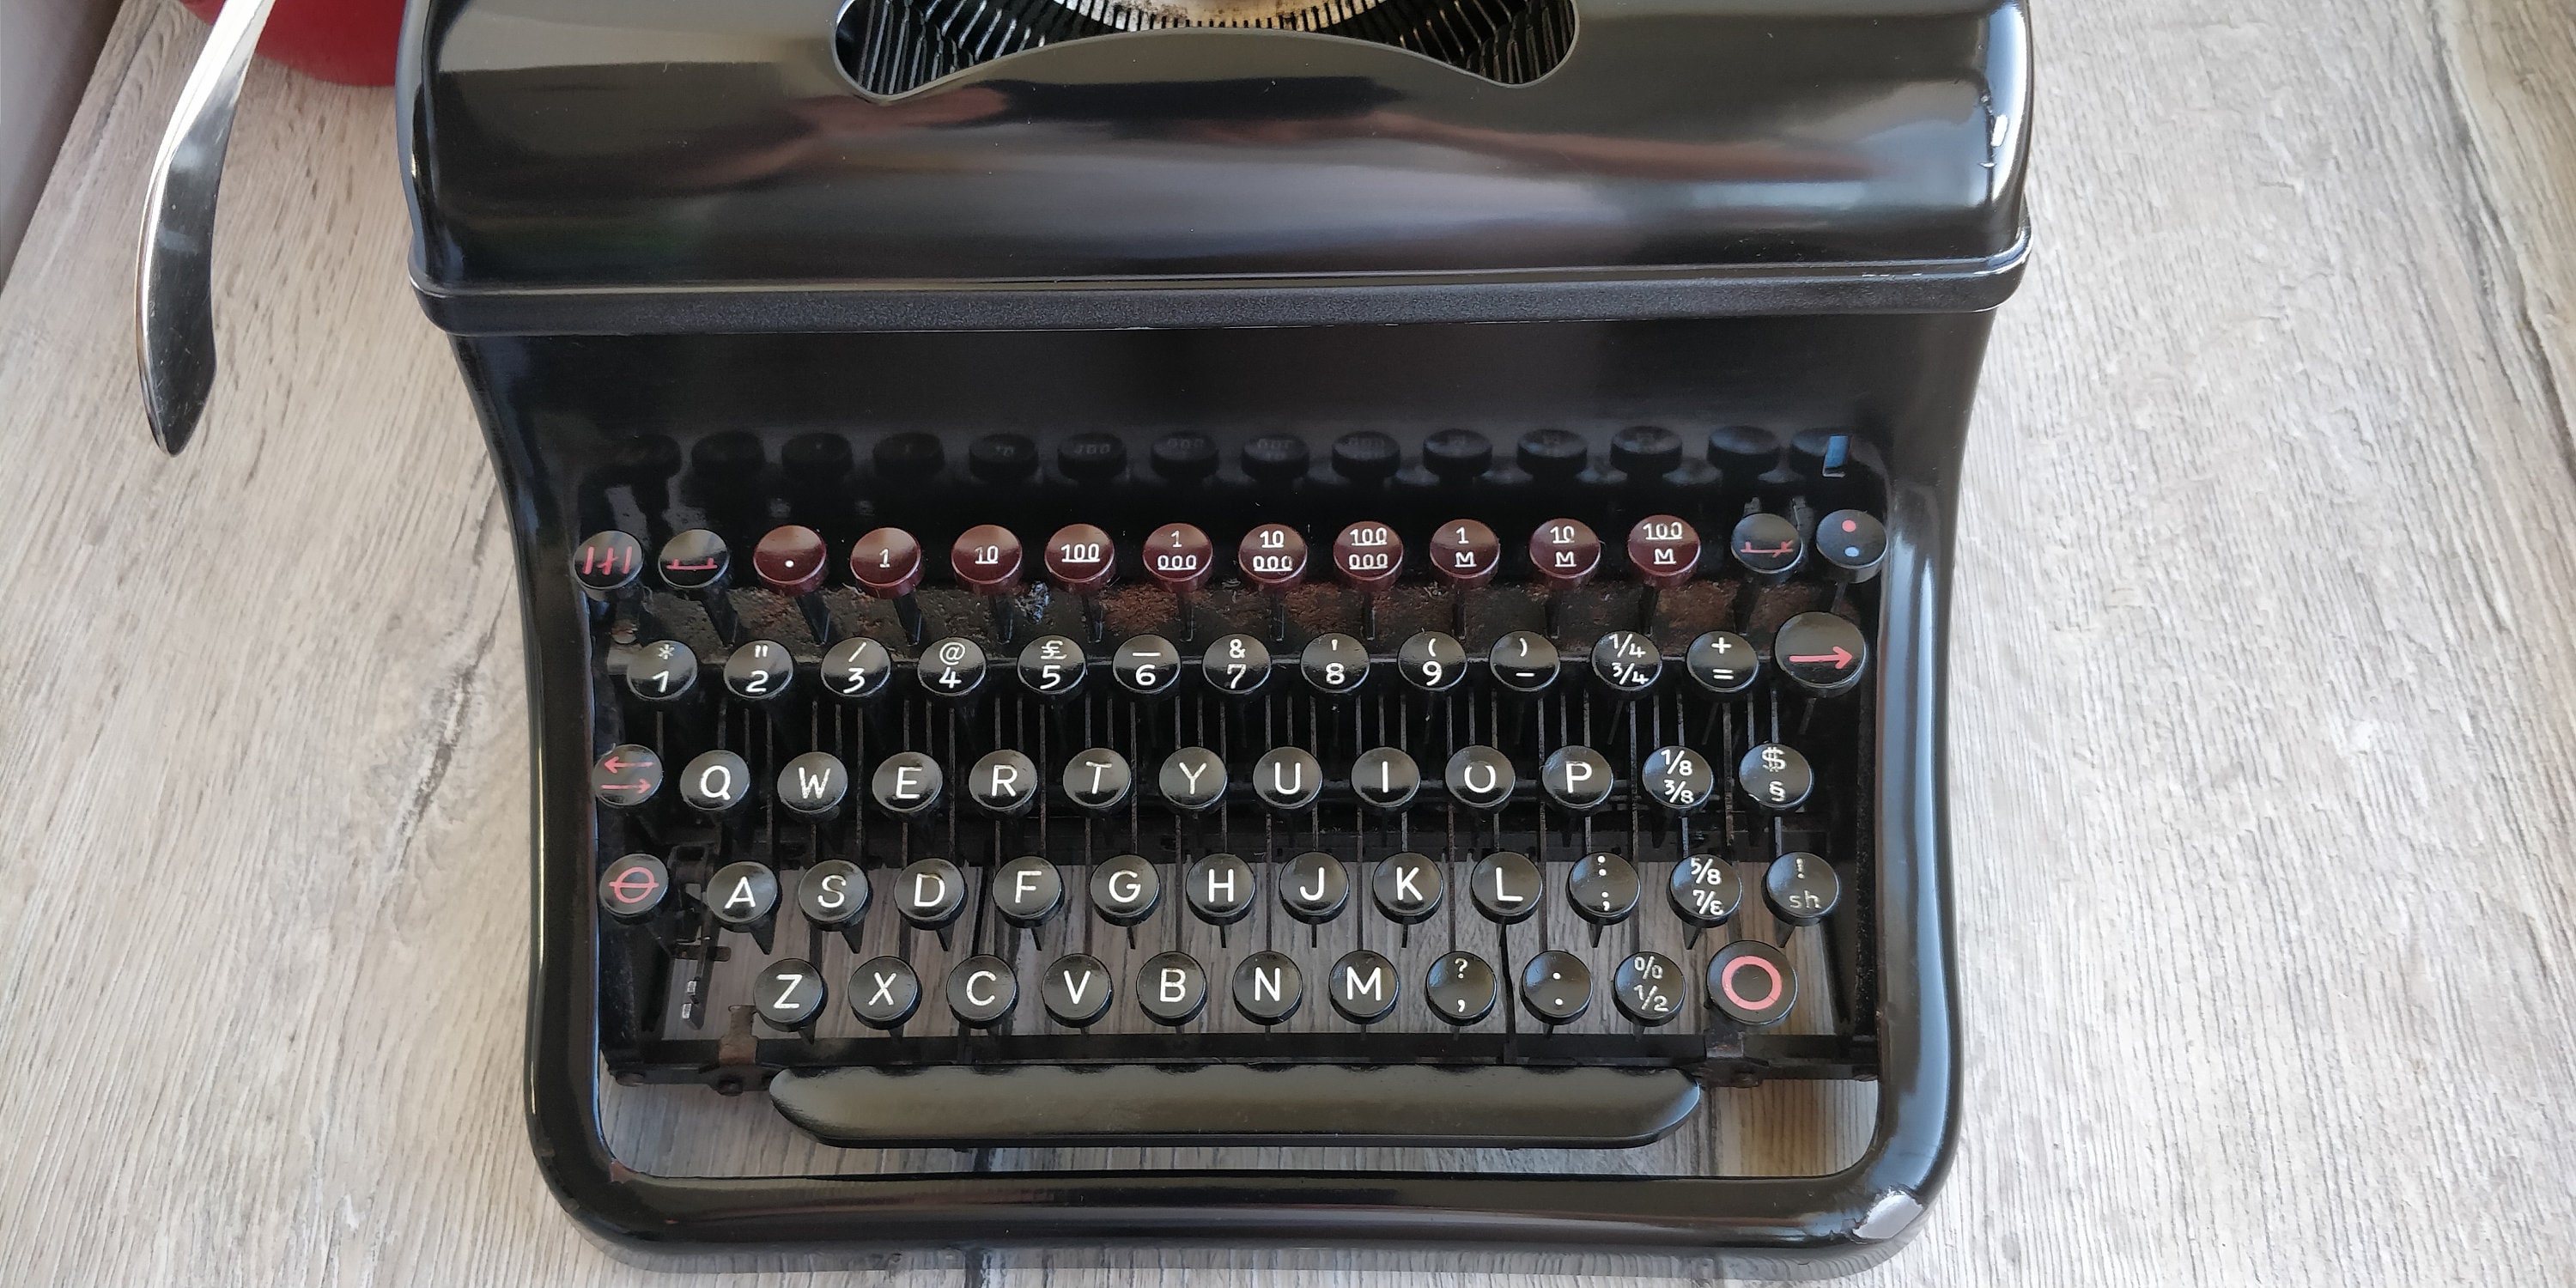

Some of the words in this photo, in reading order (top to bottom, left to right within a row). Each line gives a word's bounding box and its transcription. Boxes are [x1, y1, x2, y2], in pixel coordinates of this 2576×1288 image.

[1170, 530, 1182, 548] 1
[1260, 530, 1285, 549] 10
[1349, 527, 1388, 546] 100
[1455, 526, 1469, 544] 1
[1550, 526, 1575, 544] 10
[1643, 521, 1683, 541] 100
[879, 548, 890, 568] 1
[975, 545, 999, 565] 10
[1060, 543, 1101, 563] 100
[1157, 554, 1197, 571] 000
[1253, 555, 1293, 572] 000
[1348, 553, 1388, 570] 000
[1455, 551, 1477, 568] M
[1554, 550, 1577, 568] M
[1653, 548, 1677, 565] M
[939, 641, 966, 665] @
[1040, 640, 1067, 660] £
[1229, 638, 1246, 659] &
[1710, 636, 1732, 654] +
[651, 670, 670, 693] 1
[745, 670, 769, 693] 2
[842, 667, 866, 694] 3
[939, 666, 962, 689] 4
[1040, 664, 1061, 690] 5
[1135, 664, 1156, 686] 6
[1226, 663, 1247, 690] 7
[1325, 662, 1346, 685] 8
[1422, 660, 1443, 686] 9
[1761, 746, 1786, 773] $
[700, 765, 731, 800] Q
[799, 767, 831, 799] W
[896, 766, 923, 799] E
[991, 764, 1018, 797] R
[1085, 761, 1112, 794] T
[1179, 762, 1207, 795] Y
[1274, 762, 1301, 795] U
[1464, 762, 1497, 793] O
[1565, 761, 1593, 793] P
[1769, 781, 1786, 802] §
[724, 876, 756, 909] A
[817, 875, 847, 908] S
[914, 873, 945, 908] D
[1014, 870, 1042, 903] F
[1109, 871, 1141, 903] G
[1208, 868, 1235, 903] H
[1299, 866, 1325, 902] J
[1396, 866, 1424, 901] K
[1495, 866, 1524, 902] L
[1789, 890, 1822, 908] sh
[1455, 958, 1468, 979] ?
[1634, 956, 1663, 980] %
[773, 974, 803, 1009] Z
[868, 972, 896, 1006] X
[966, 970, 997, 1006] C
[1063, 970, 1091, 1005] V
[1159, 969, 1187, 1003] B
[1255, 967, 1281, 1002] N
[1346, 966, 1382, 1001] M
